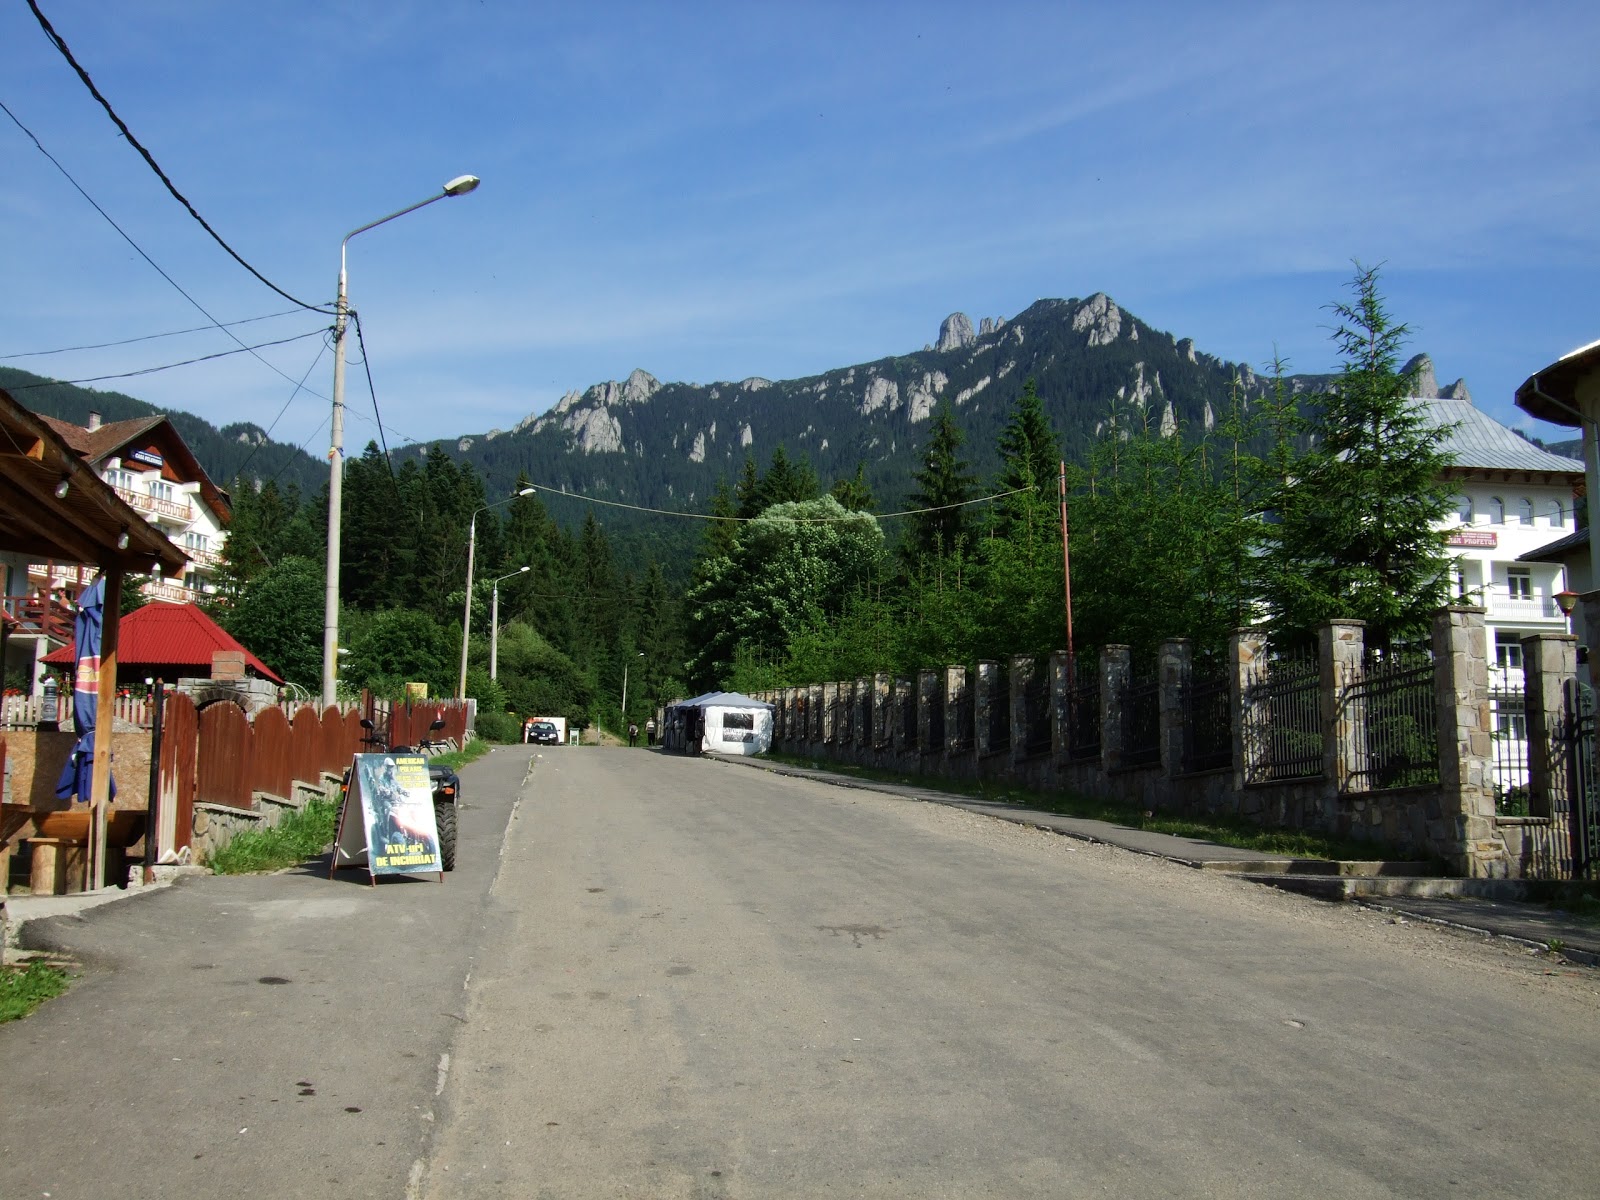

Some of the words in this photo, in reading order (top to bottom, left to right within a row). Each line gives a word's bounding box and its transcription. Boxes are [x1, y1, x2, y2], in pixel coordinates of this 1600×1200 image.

[396, 757, 425, 765] AMERICAN
[387, 843, 423, 854] ATV-uri
[376, 857, 388, 867] DE
[390, 854, 435, 866] INCHIRIAT
